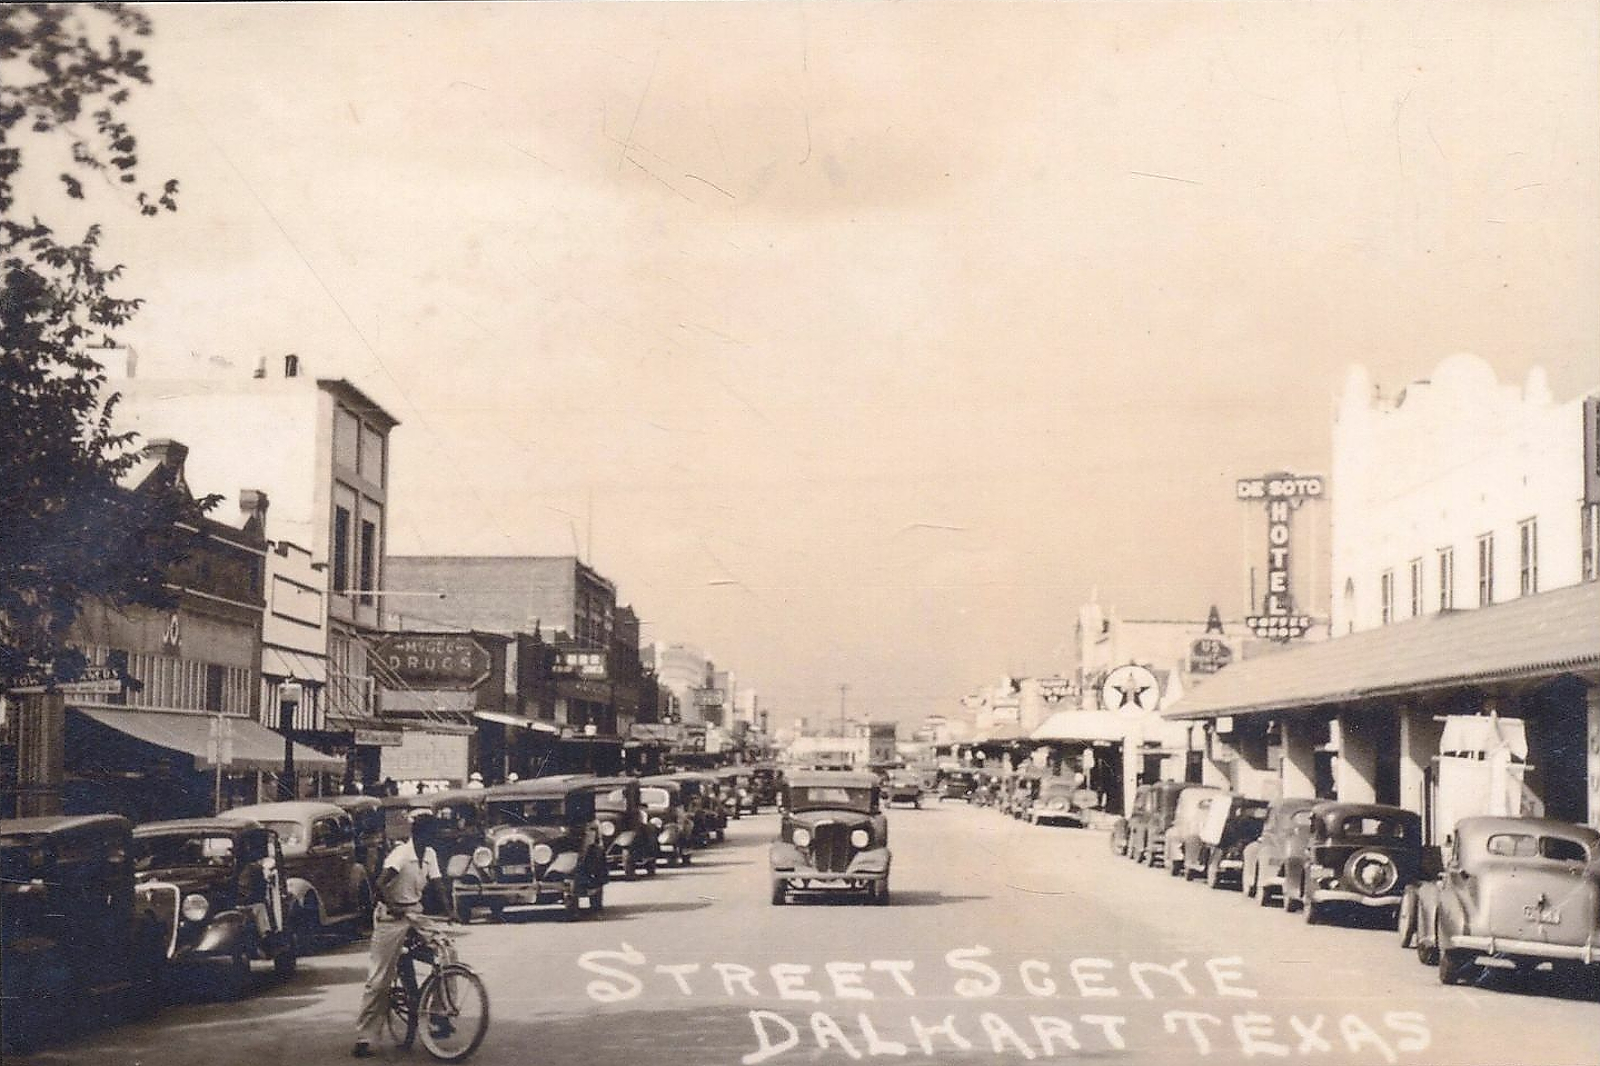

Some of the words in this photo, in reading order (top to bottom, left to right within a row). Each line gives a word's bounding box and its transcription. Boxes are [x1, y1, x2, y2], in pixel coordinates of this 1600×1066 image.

[1237, 480, 1265, 498] DE
[1268, 479, 1321, 497] SOTO
[1269, 500, 1289, 616] HOTEL
[389, 651, 473, 671] DRUGS
